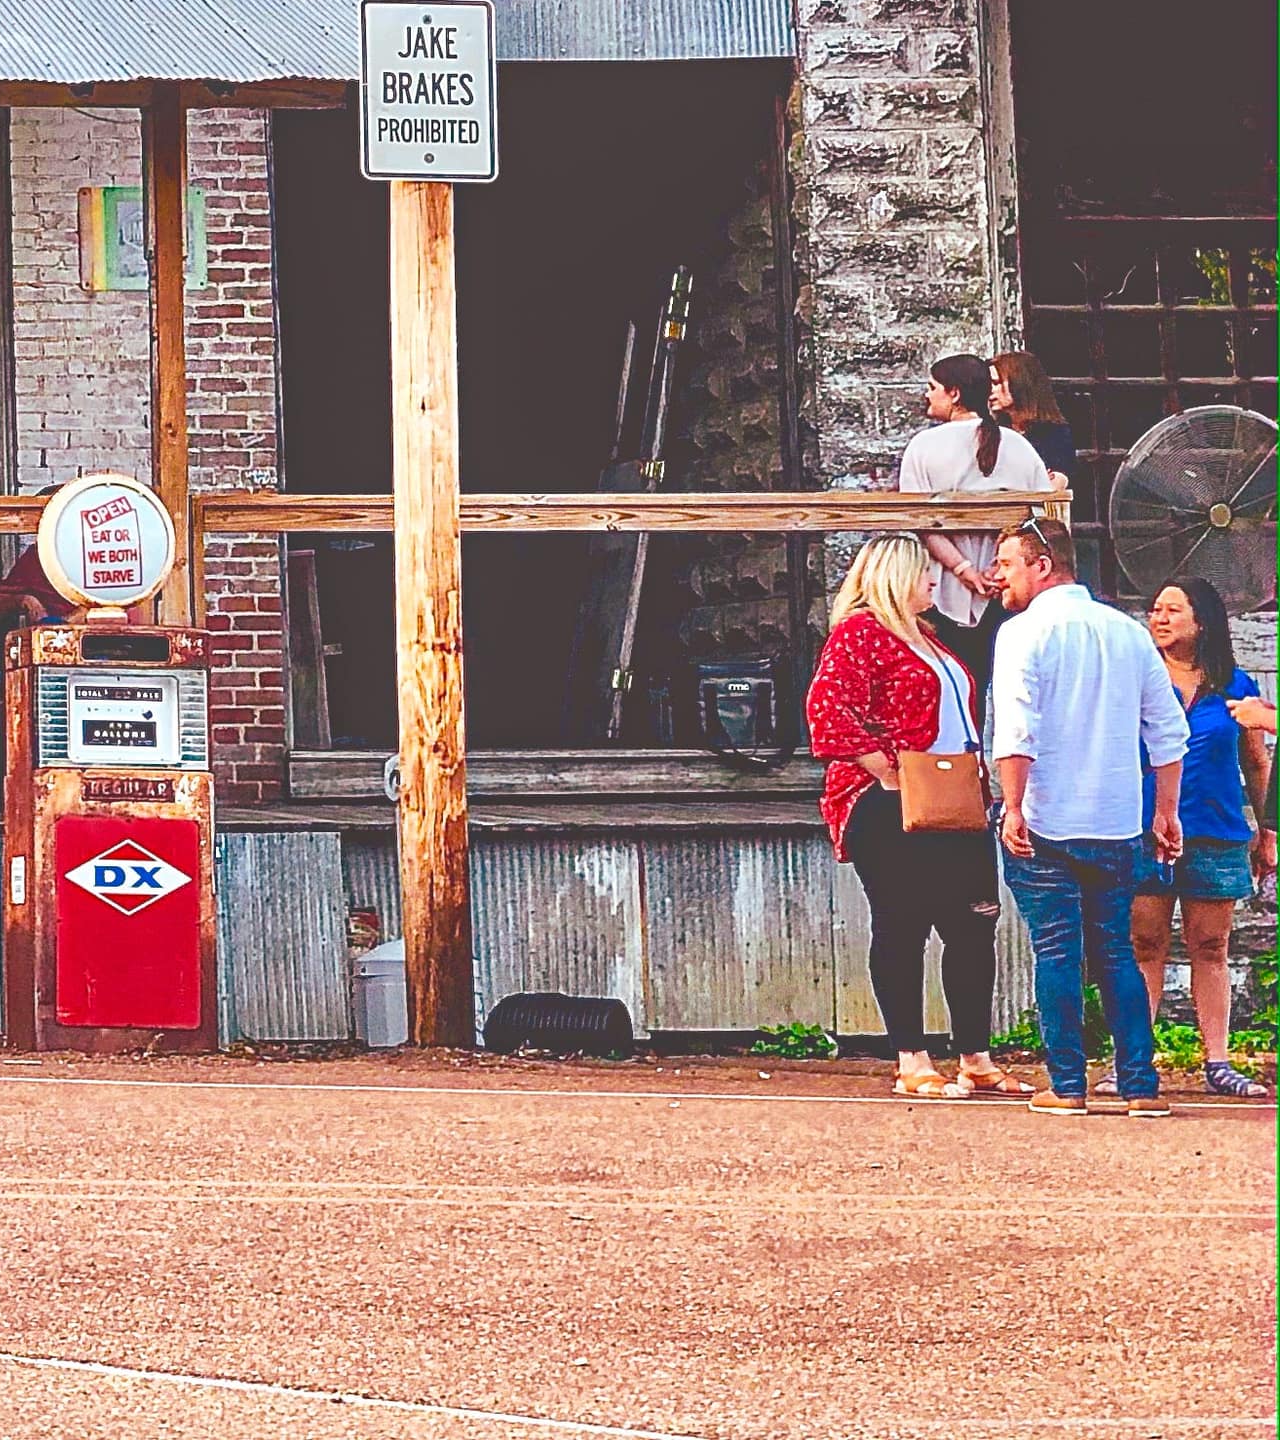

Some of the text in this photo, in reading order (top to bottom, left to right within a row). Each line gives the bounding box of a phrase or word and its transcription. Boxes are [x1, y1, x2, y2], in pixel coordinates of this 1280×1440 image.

[398, 26, 458, 59] JAKE
[382, 72, 474, 105] BRAKES
[377, 118, 480, 144] PROHIBITED
[87, 499, 131, 527] OPEN
[91, 528, 130, 543] EAT OR
[88, 548, 138, 564] WE BOTH
[93, 569, 134, 584] STARVE
[94, 730, 146, 738] GALLONS
[90, 781, 167, 796] REGULAR
[94, 864, 164, 889] DX
